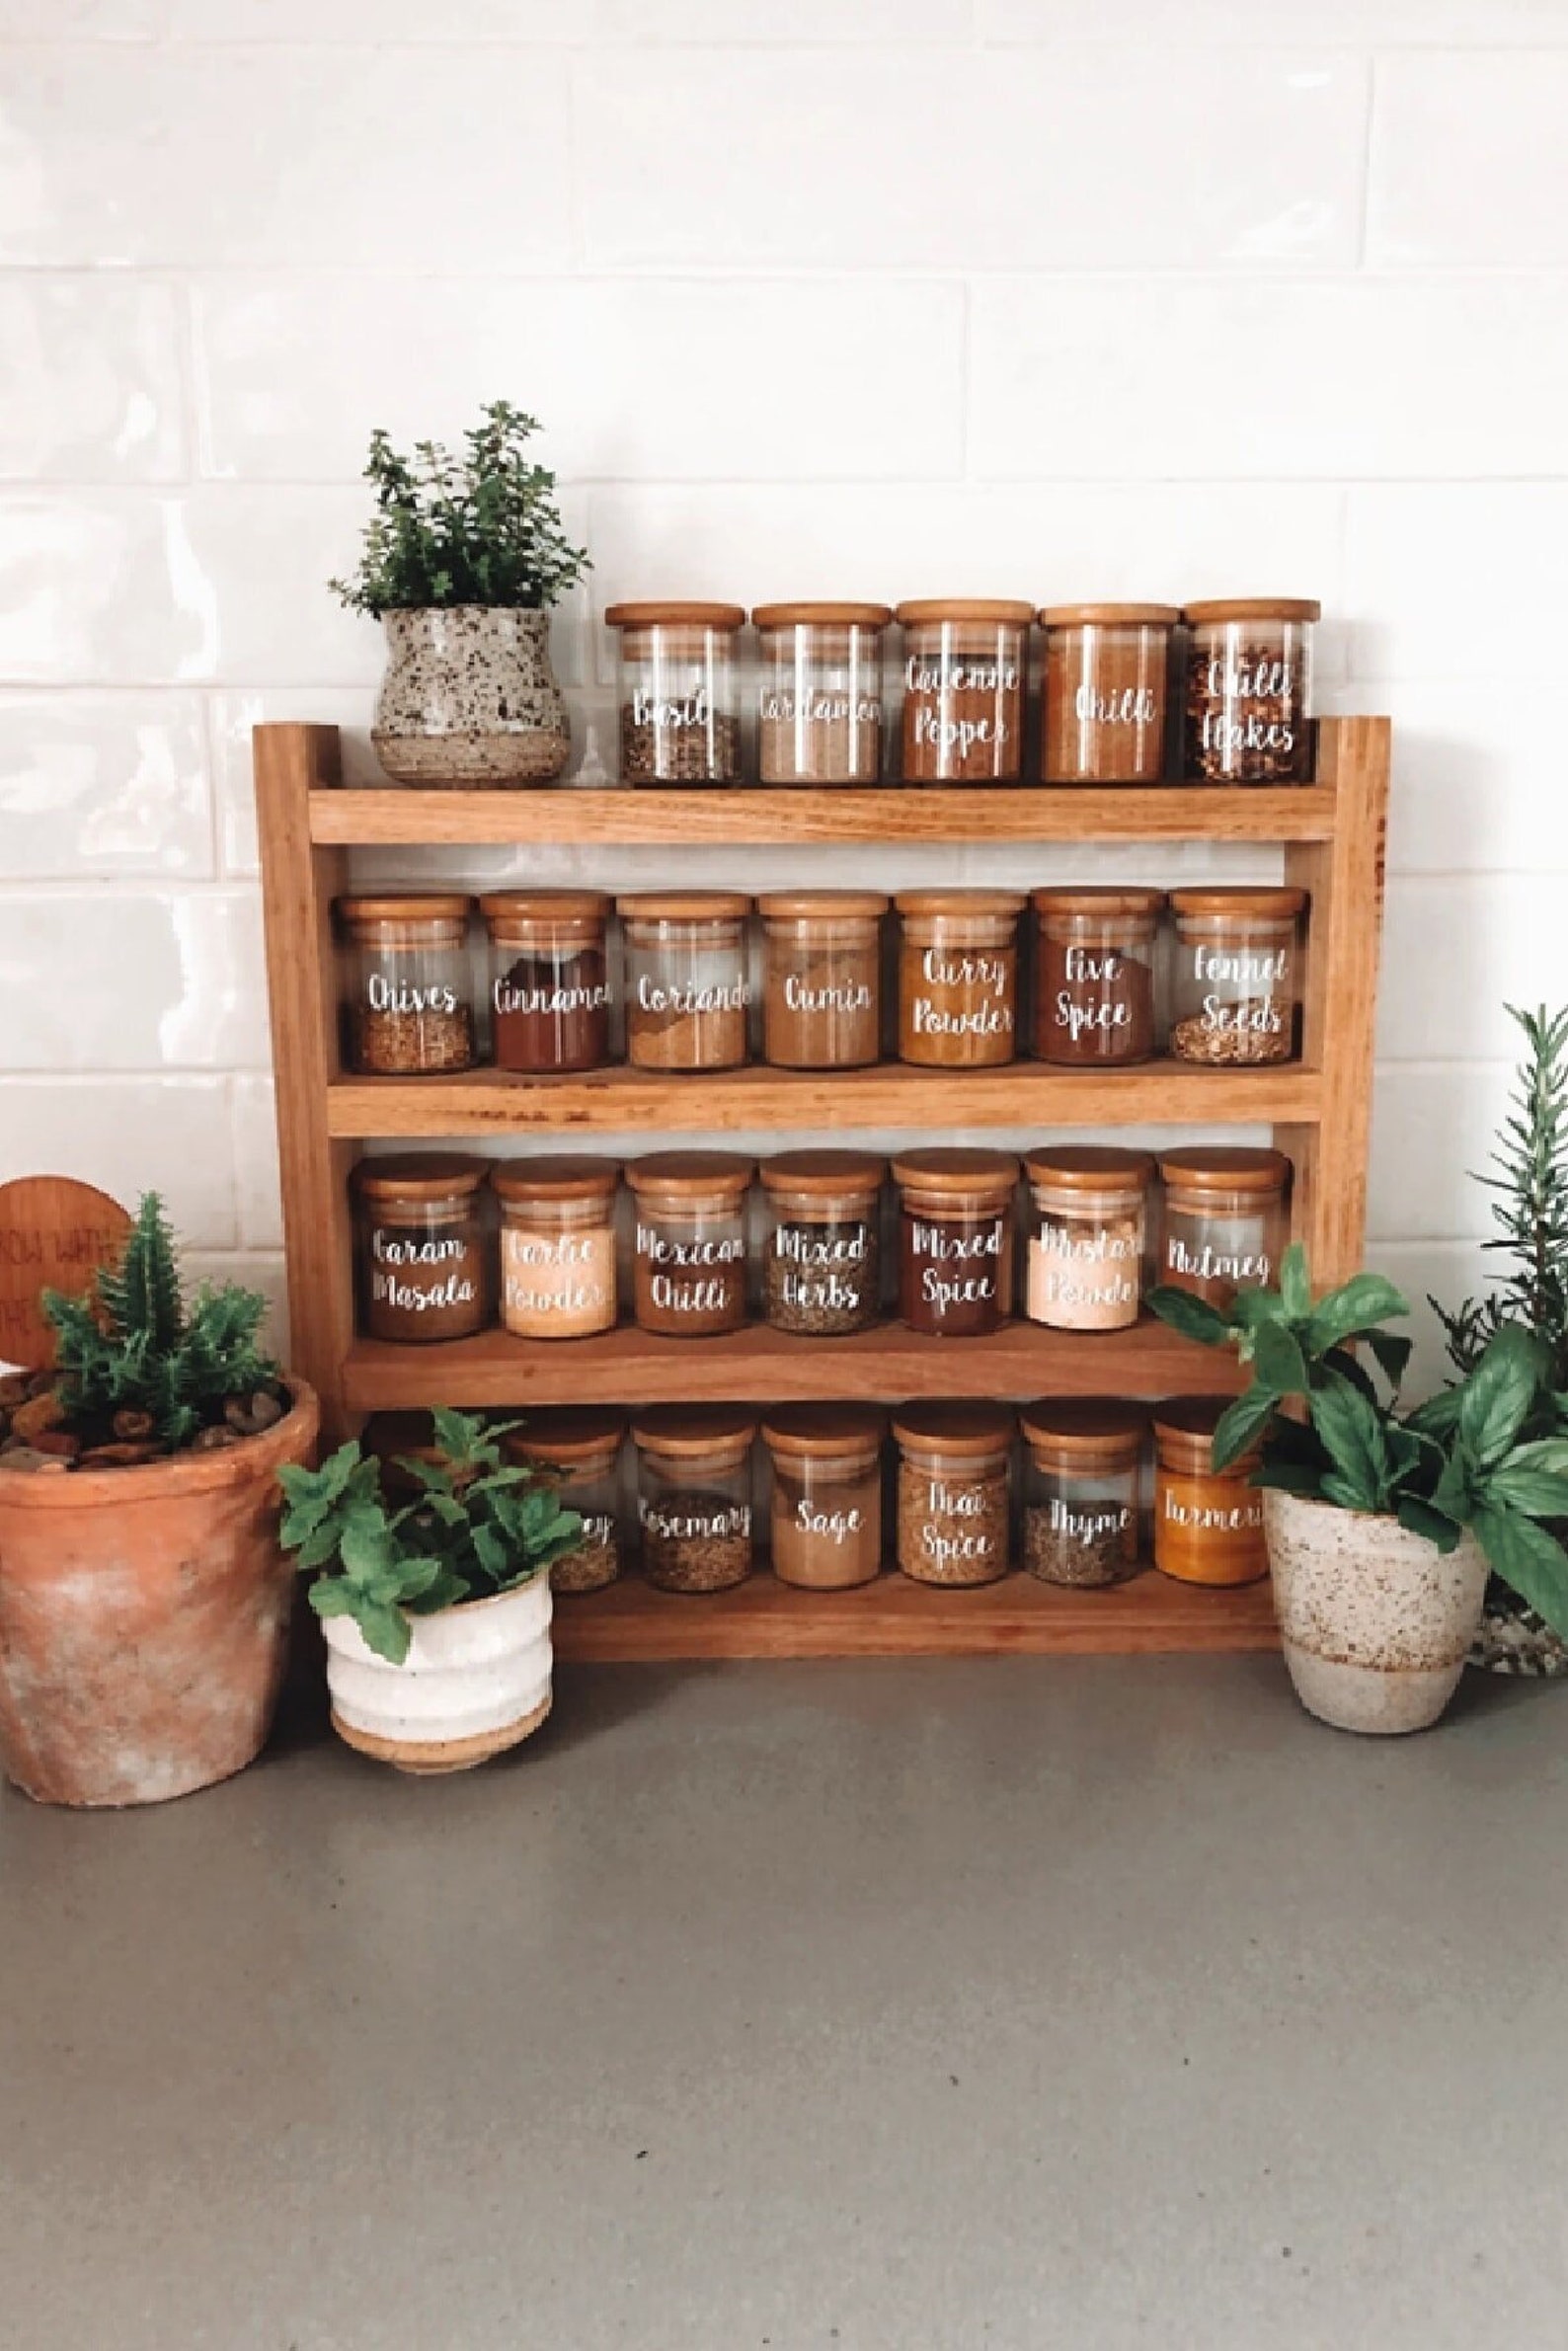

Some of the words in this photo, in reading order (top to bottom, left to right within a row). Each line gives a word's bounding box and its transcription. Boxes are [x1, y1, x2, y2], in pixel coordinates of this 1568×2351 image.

[906, 655, 1020, 705] Cayenne
[1208, 660, 1294, 697] Chilli
[633, 687, 710, 727] Basil
[1075, 684, 1156, 727] Chilli
[915, 706, 1009, 759] Pepper
[1203, 710, 1294, 752] Flakes
[922, 948, 1005, 996] Curry
[1065, 946, 1124, 983] Five
[1194, 945, 1289, 982] Fennel
[368, 974, 458, 1013] Chives
[785, 975, 870, 1012] Cumin
[1201, 994, 1283, 1033] Seeds
[912, 997, 1013, 1036] Powder
[1054, 989, 1133, 1041] Spice
[372, 1229, 467, 1265] Garam
[509, 1230, 592, 1265] Garlic
[636, 1221, 745, 1266] Mexican
[776, 1224, 868, 1265] Mixed
[912, 1220, 1004, 1259] Mixed
[1168, 1235, 1271, 1288] Nutmeg
[372, 1271, 478, 1311] Masala
[505, 1275, 607, 1312] Powder
[651, 1274, 732, 1311] Chilli
[783, 1274, 860, 1309] Herbs
[922, 1267, 995, 1316] Spice
[929, 1481, 989, 1517] Thai
[1165, 1487, 1264, 1532] Turmeri
[795, 1499, 866, 1545] Sage
[1051, 1498, 1133, 1545] Thyme
[920, 1524, 995, 1571] Spice
